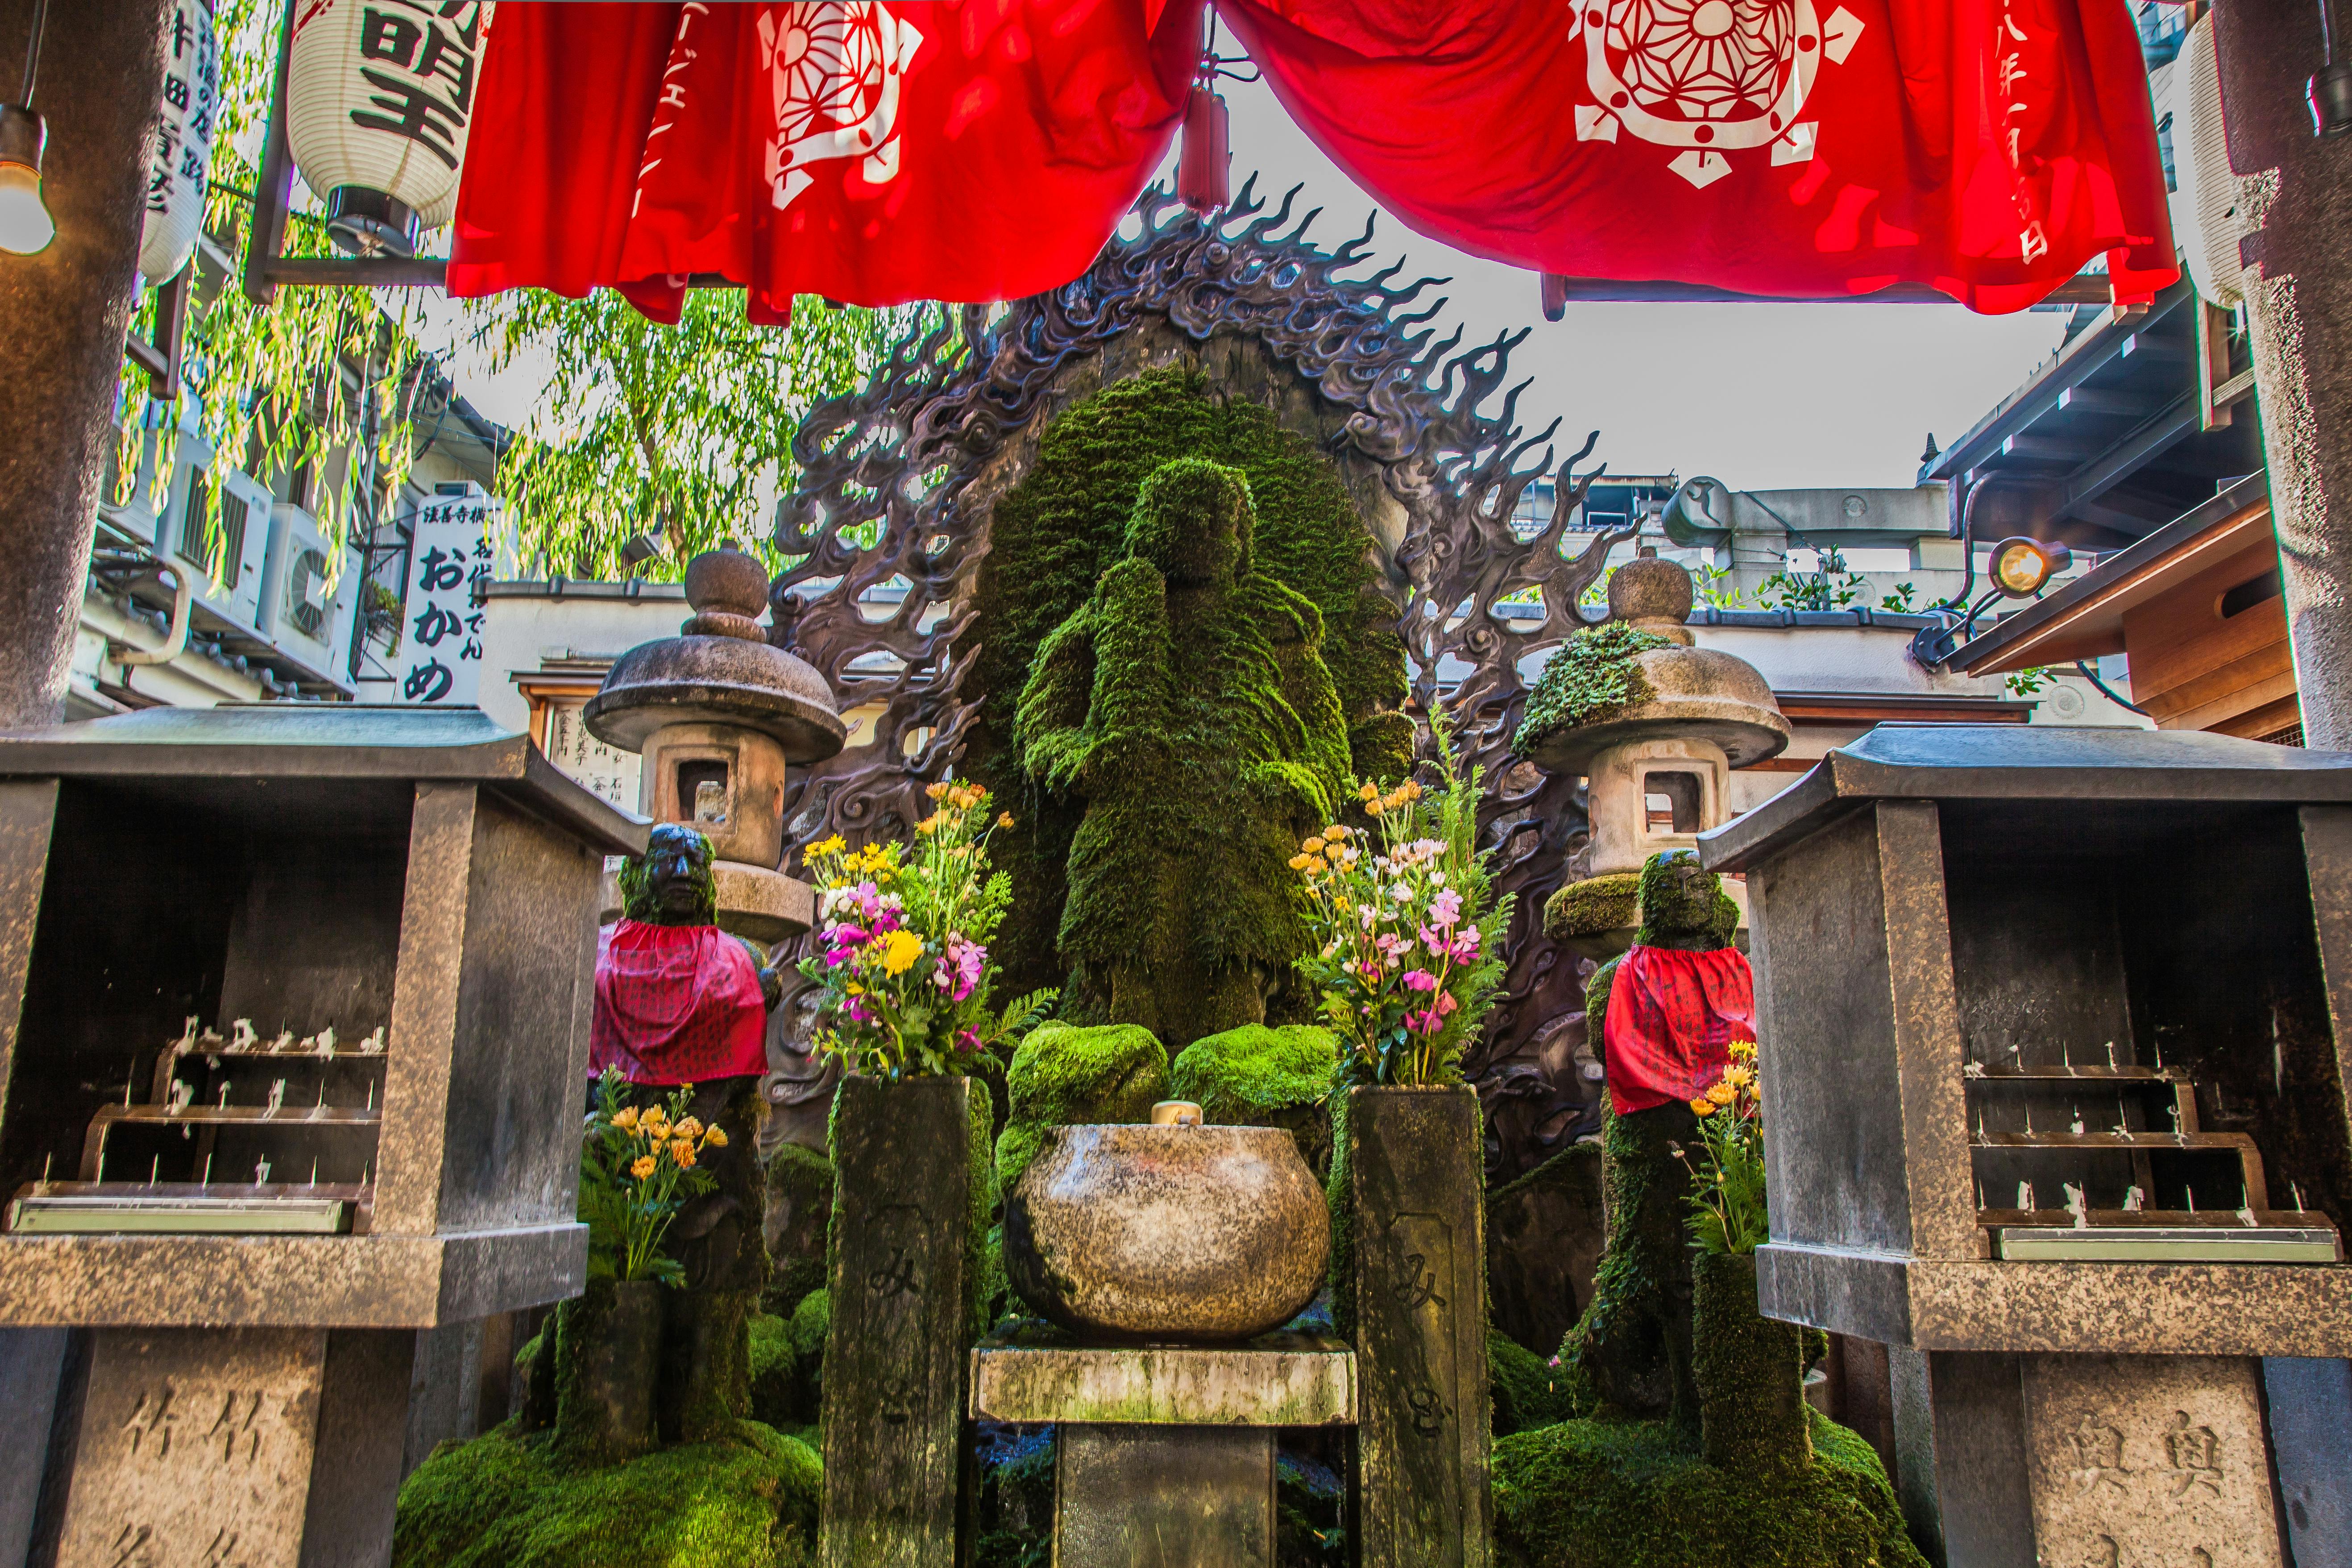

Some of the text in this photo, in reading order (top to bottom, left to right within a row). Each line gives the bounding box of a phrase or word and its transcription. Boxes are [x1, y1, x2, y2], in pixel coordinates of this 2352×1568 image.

[350, 0, 483, 170] 明王
[1995, 0, 2048, 265] 八年一月吉日
[404, 545, 467, 702] おかめ
